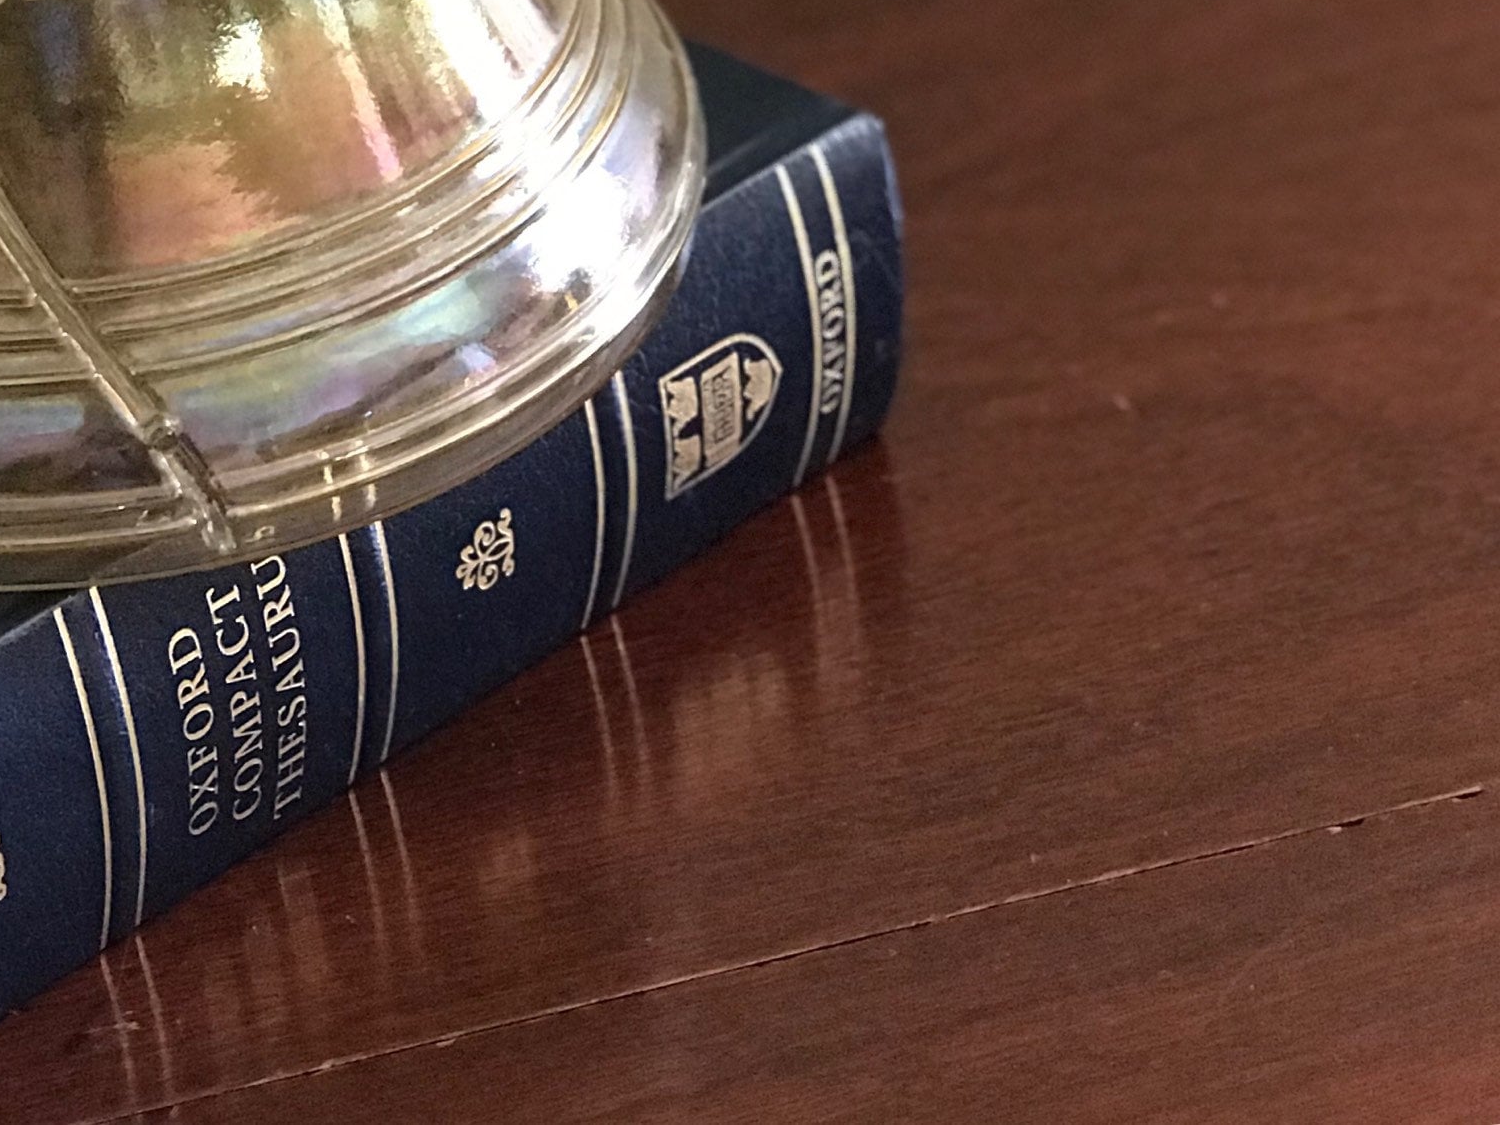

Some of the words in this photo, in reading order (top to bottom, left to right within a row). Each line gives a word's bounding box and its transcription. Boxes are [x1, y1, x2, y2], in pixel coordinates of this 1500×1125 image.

[815, 249, 847, 414] OXFORD
[168, 627, 219, 835] OXFORD
[205, 584, 264, 820] COMPACT
